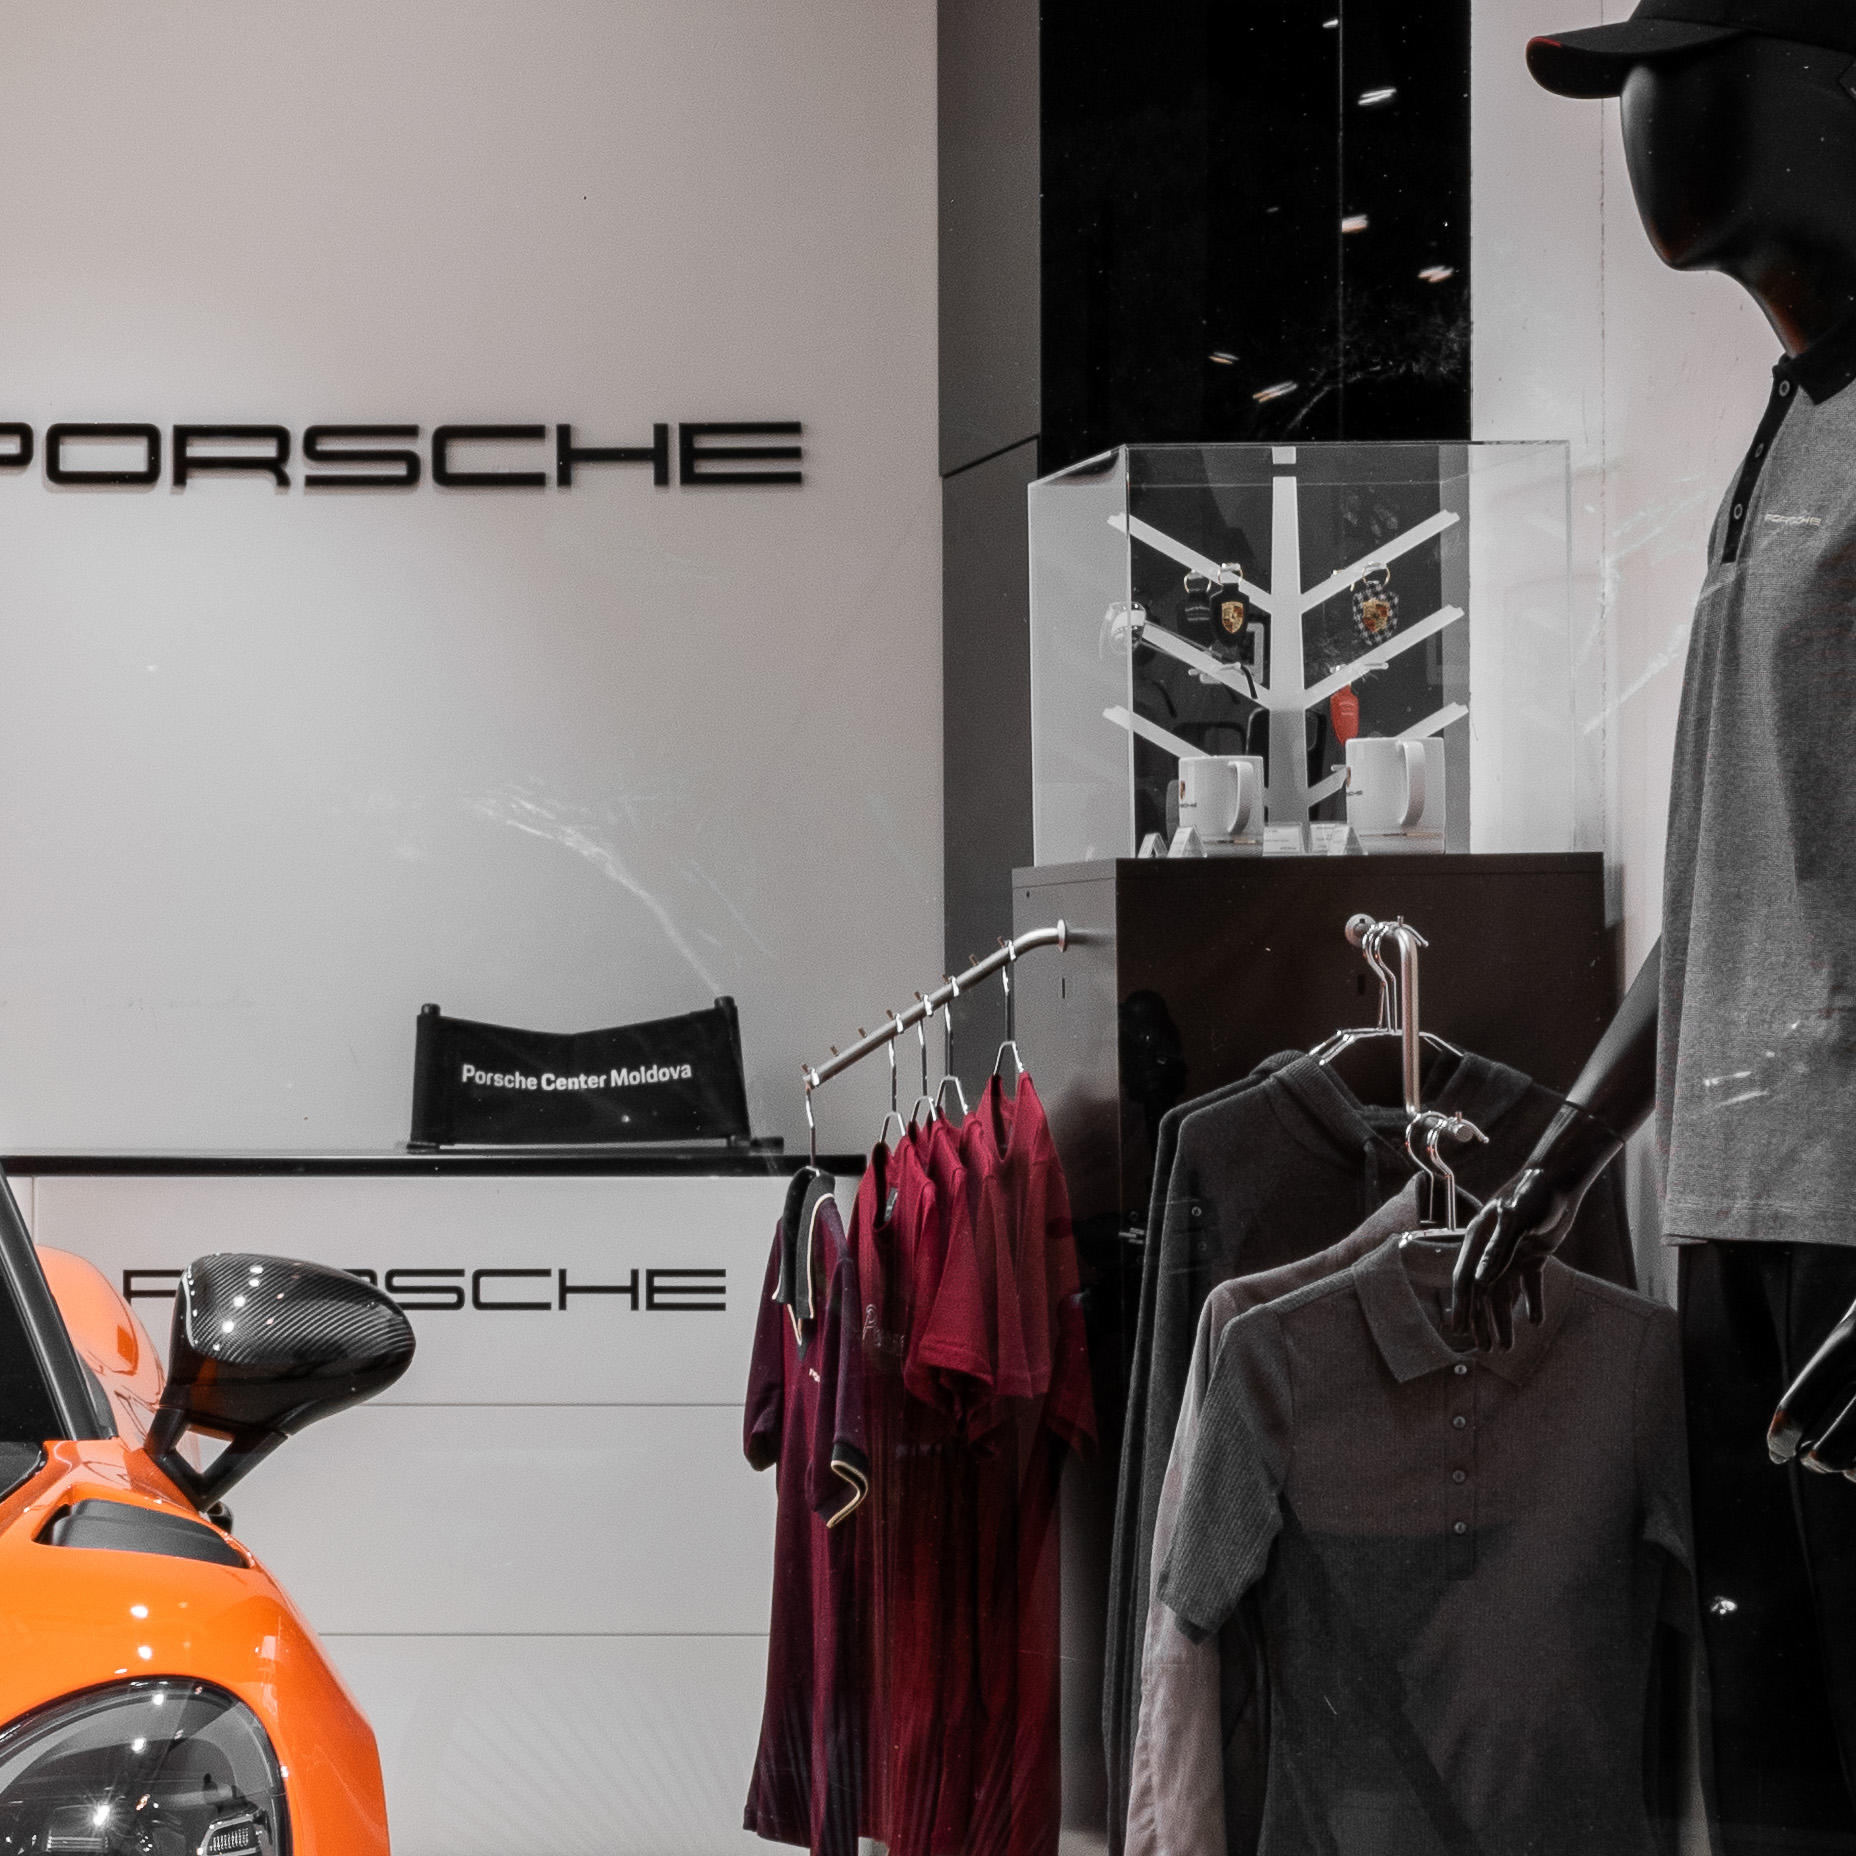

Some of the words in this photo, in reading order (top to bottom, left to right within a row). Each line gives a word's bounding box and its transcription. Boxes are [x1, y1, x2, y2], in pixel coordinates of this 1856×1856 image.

[461, 1063, 538, 1090] Porsche
[540, 1072, 607, 1091] Center
[610, 1063, 692, 1087] Moldova
[123, 1268, 727, 1312] PSCHE
